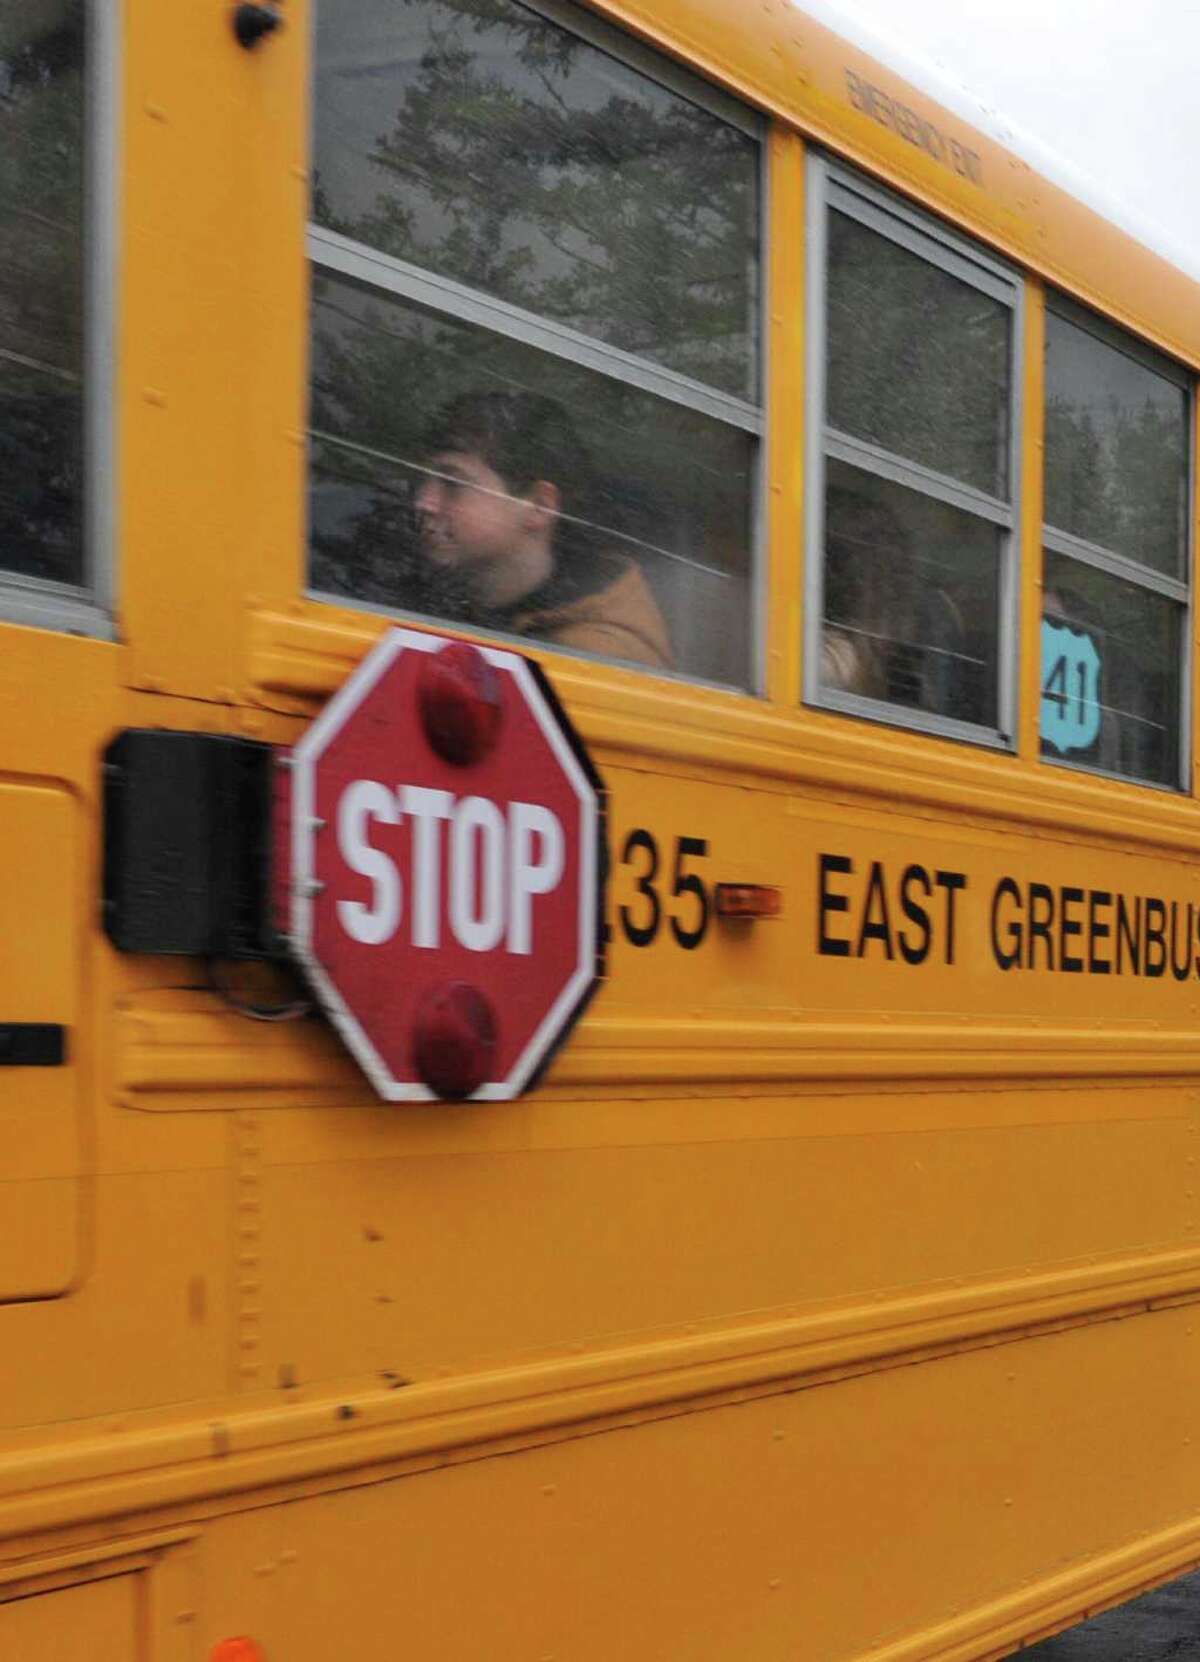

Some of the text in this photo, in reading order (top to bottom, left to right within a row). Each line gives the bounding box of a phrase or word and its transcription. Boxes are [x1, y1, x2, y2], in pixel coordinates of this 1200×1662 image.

[1041, 655, 1087, 726] 41
[336, 779, 566, 955] STOP
[604, 828, 714, 950] 35
[816, 853, 967, 966] EAST
